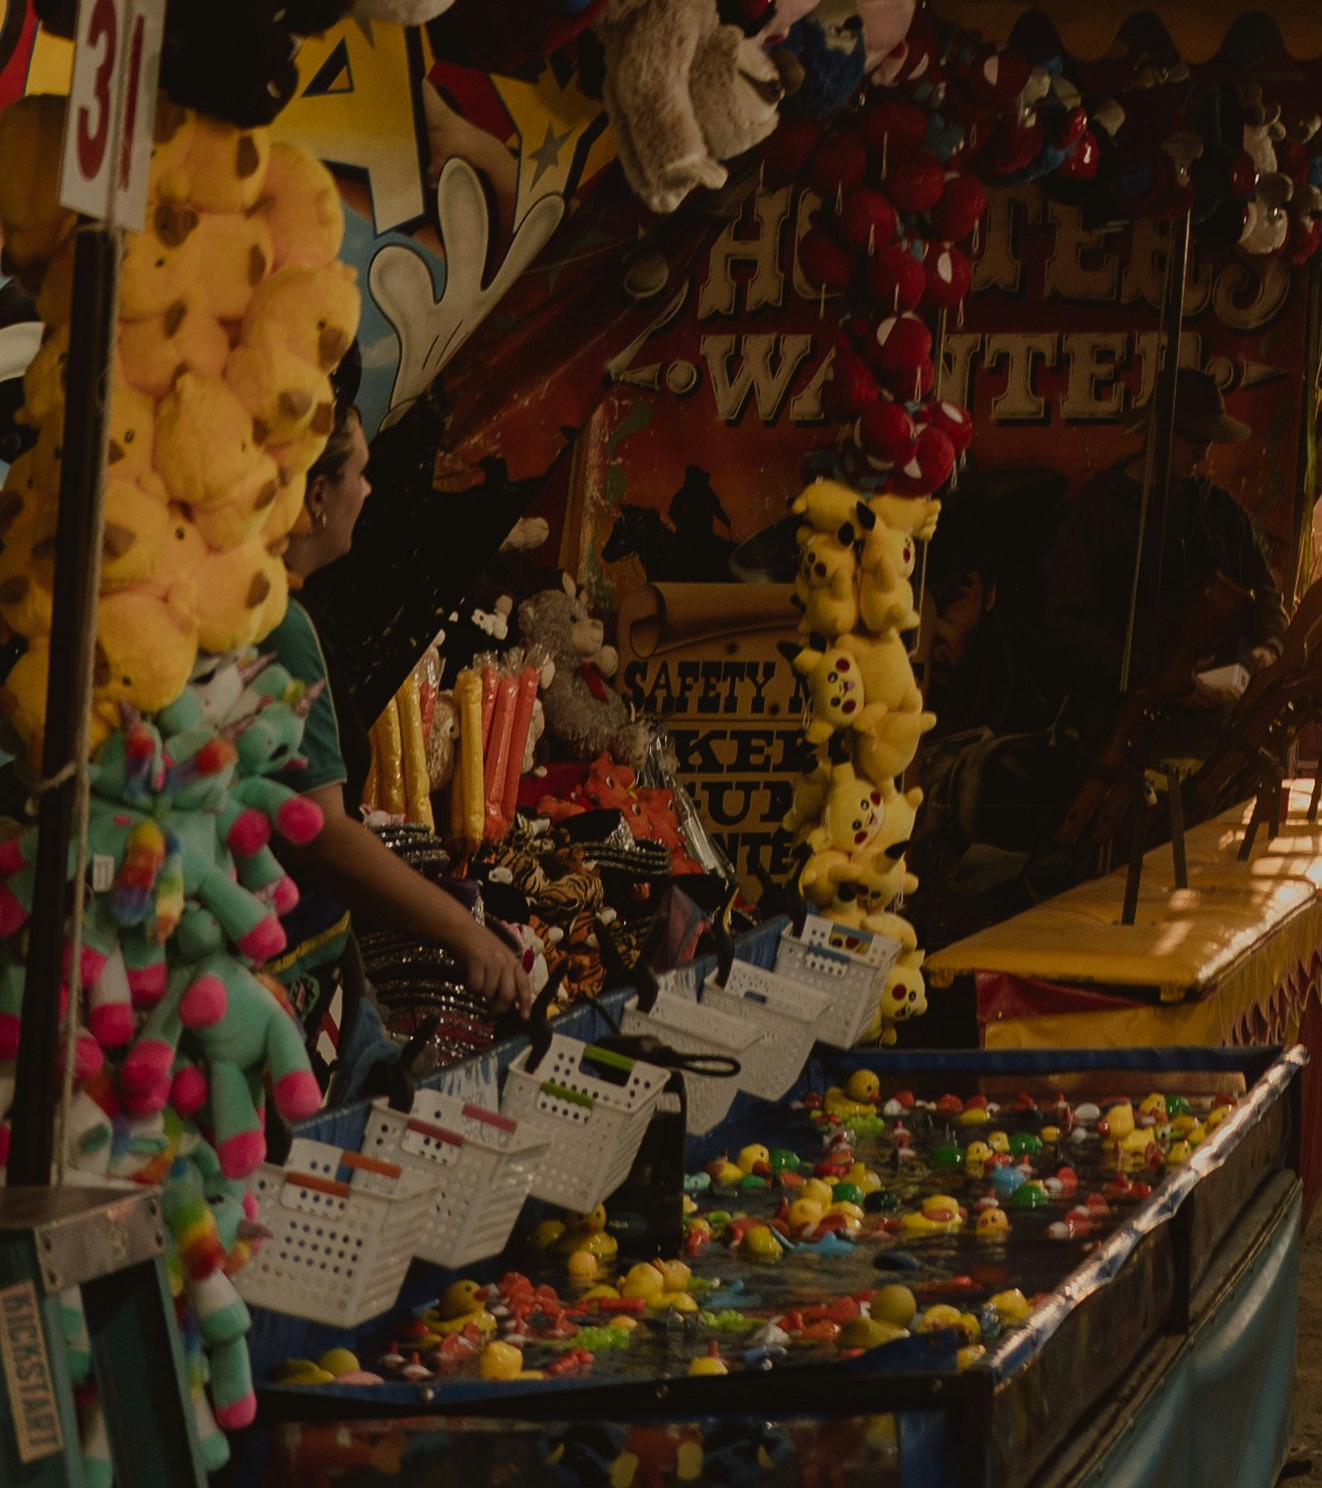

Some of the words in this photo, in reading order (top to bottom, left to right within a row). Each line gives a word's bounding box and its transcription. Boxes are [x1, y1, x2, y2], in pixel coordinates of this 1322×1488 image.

[698, 185, 1292, 331] HTERS
[699, 333, 1204, 420] WNTE
[624, 660, 776, 714] SAFETY
[3, 1292, 59, 1446] KICKSTART
